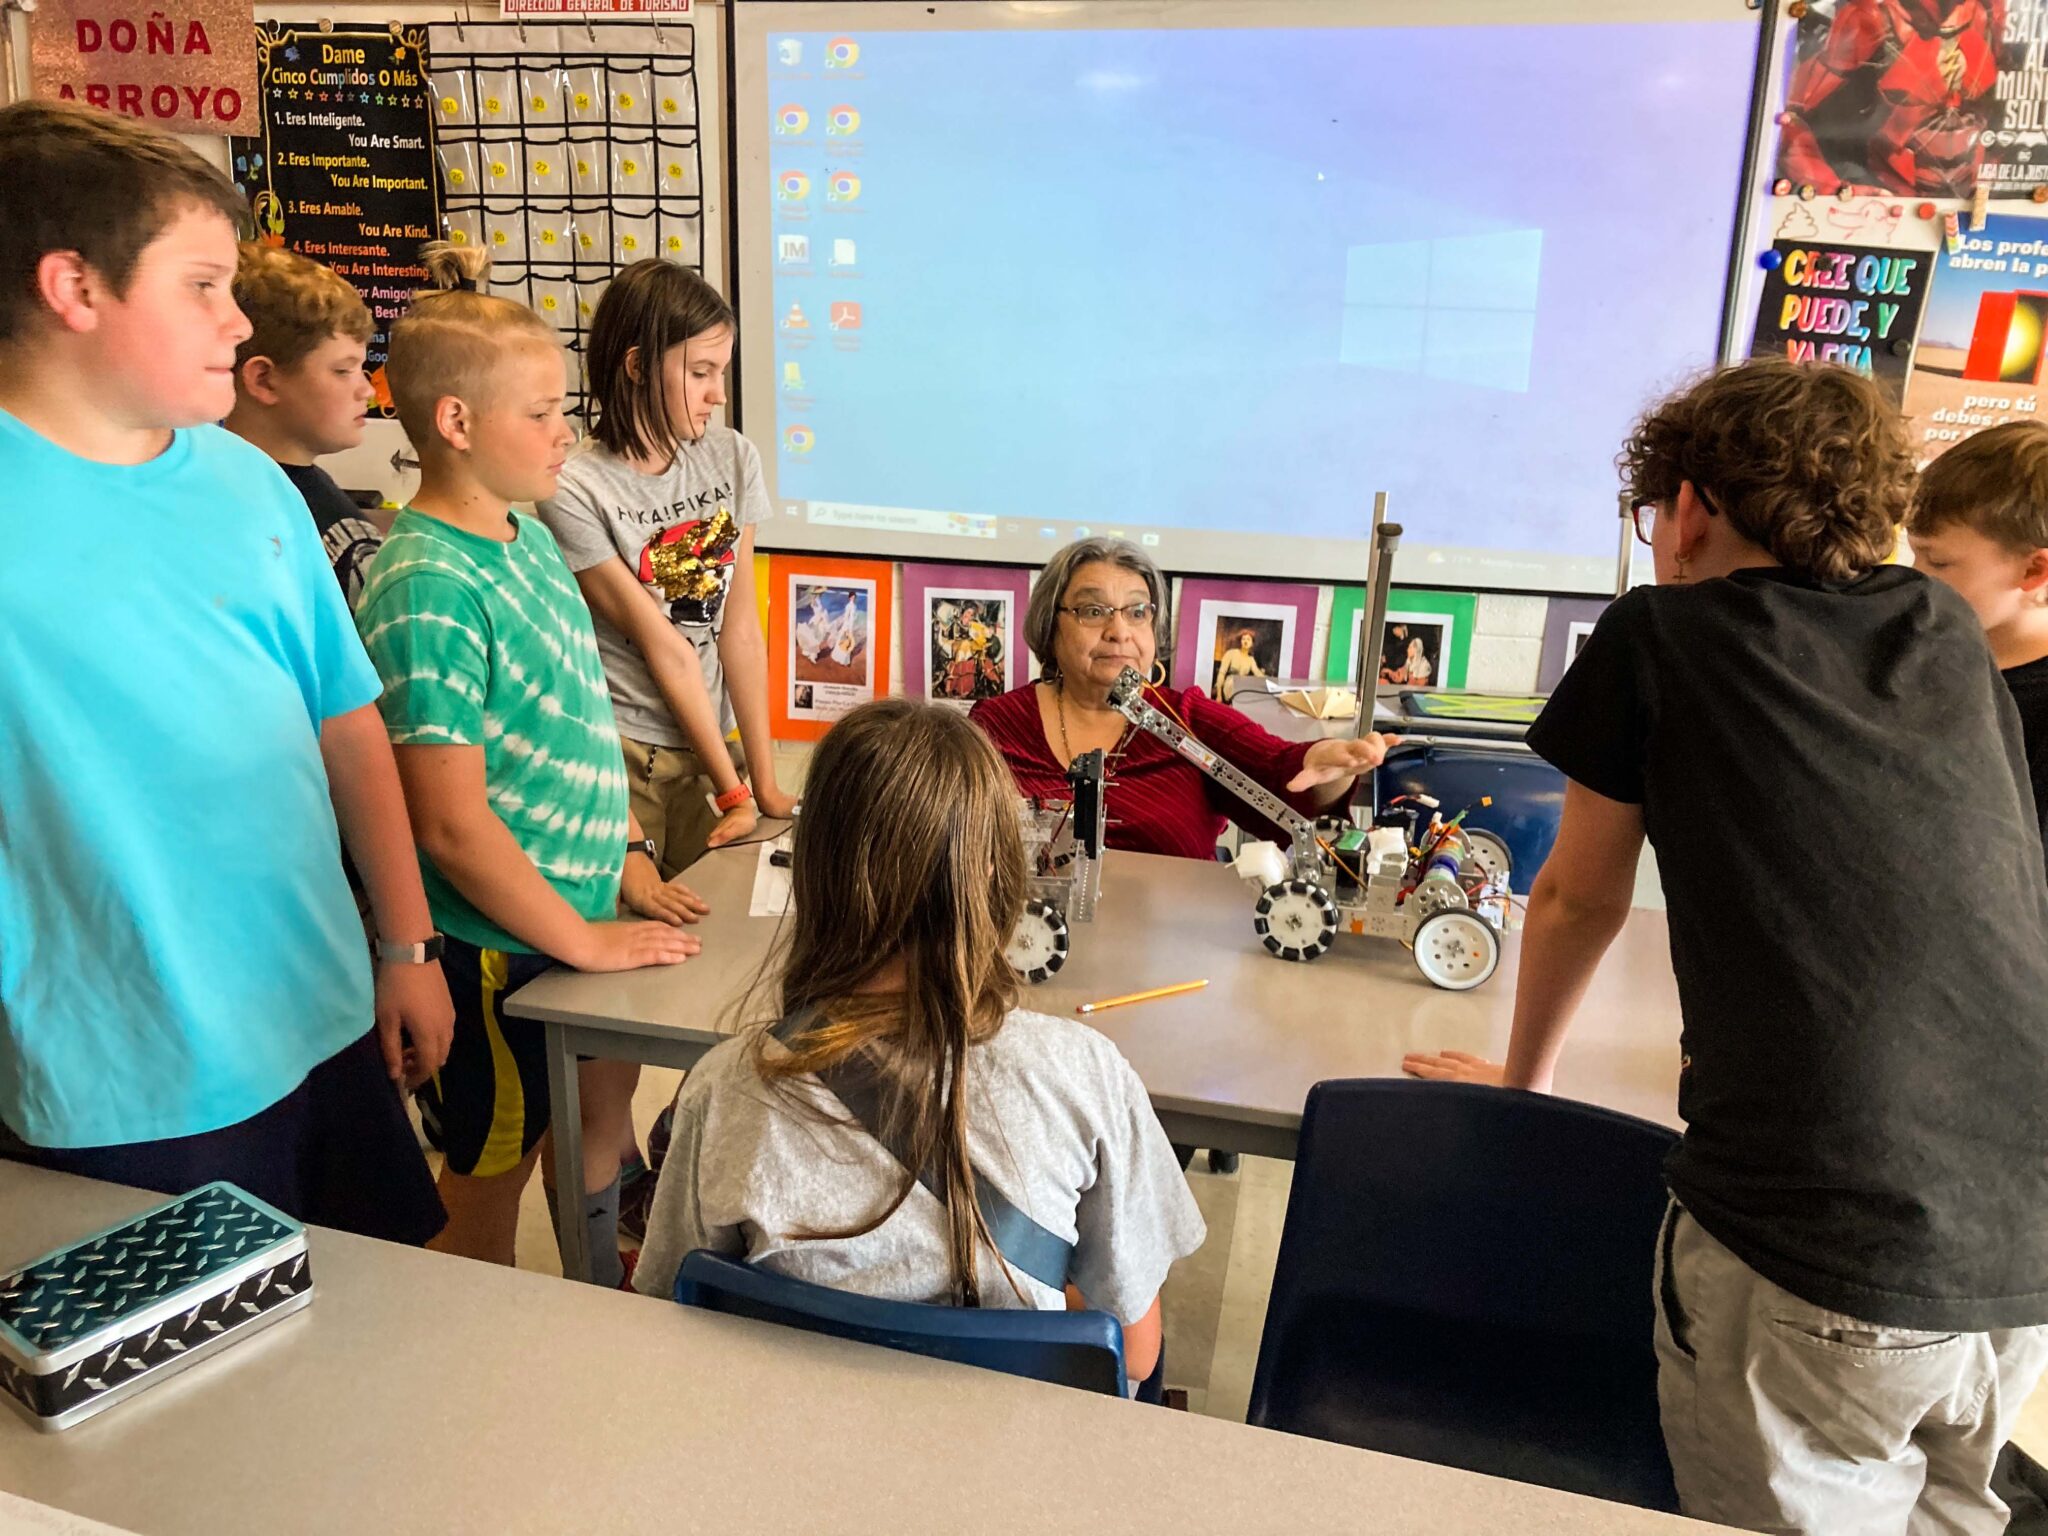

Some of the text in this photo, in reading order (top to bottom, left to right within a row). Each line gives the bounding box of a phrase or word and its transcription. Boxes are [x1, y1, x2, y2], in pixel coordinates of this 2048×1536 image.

[566, 0, 615, 11] GENERAL
[620, 0, 633, 11] DE
[639, 0, 687, 11] TURISMO
[76, 11, 212, 55] DOÑA
[322, 44, 365, 64] Dame
[272, 68, 418, 89] Cinco Cumplidos O Más
[274, 112, 365, 129] 1. Eres Inteligente.
[349, 133, 425, 149] You Are Smart.
[278, 152, 370, 170] 2. Eres Importante.
[331, 174, 428, 192] You Are Important.
[288, 201, 363, 216] 3. Eres Amable.
[359, 223, 431, 238] You Are Kind.
[293, 240, 390, 257] 4. Eres Interesante.
[784, 242, 805, 257] IM
[1960, 234, 1993, 251] Los
[329, 261, 431, 280] You Are Interesting.
[1949, 253, 2007, 271] abren
[2012, 257, 2030, 273] la
[1784, 249, 1917, 296] CREE QUE
[375, 306, 399, 318] Best
[1779, 294, 1900, 342] PUEDE, Y
[1964, 395, 2037, 411] pero tú
[1932, 407, 1993, 426] debes
[1925, 428, 1960, 441] por
